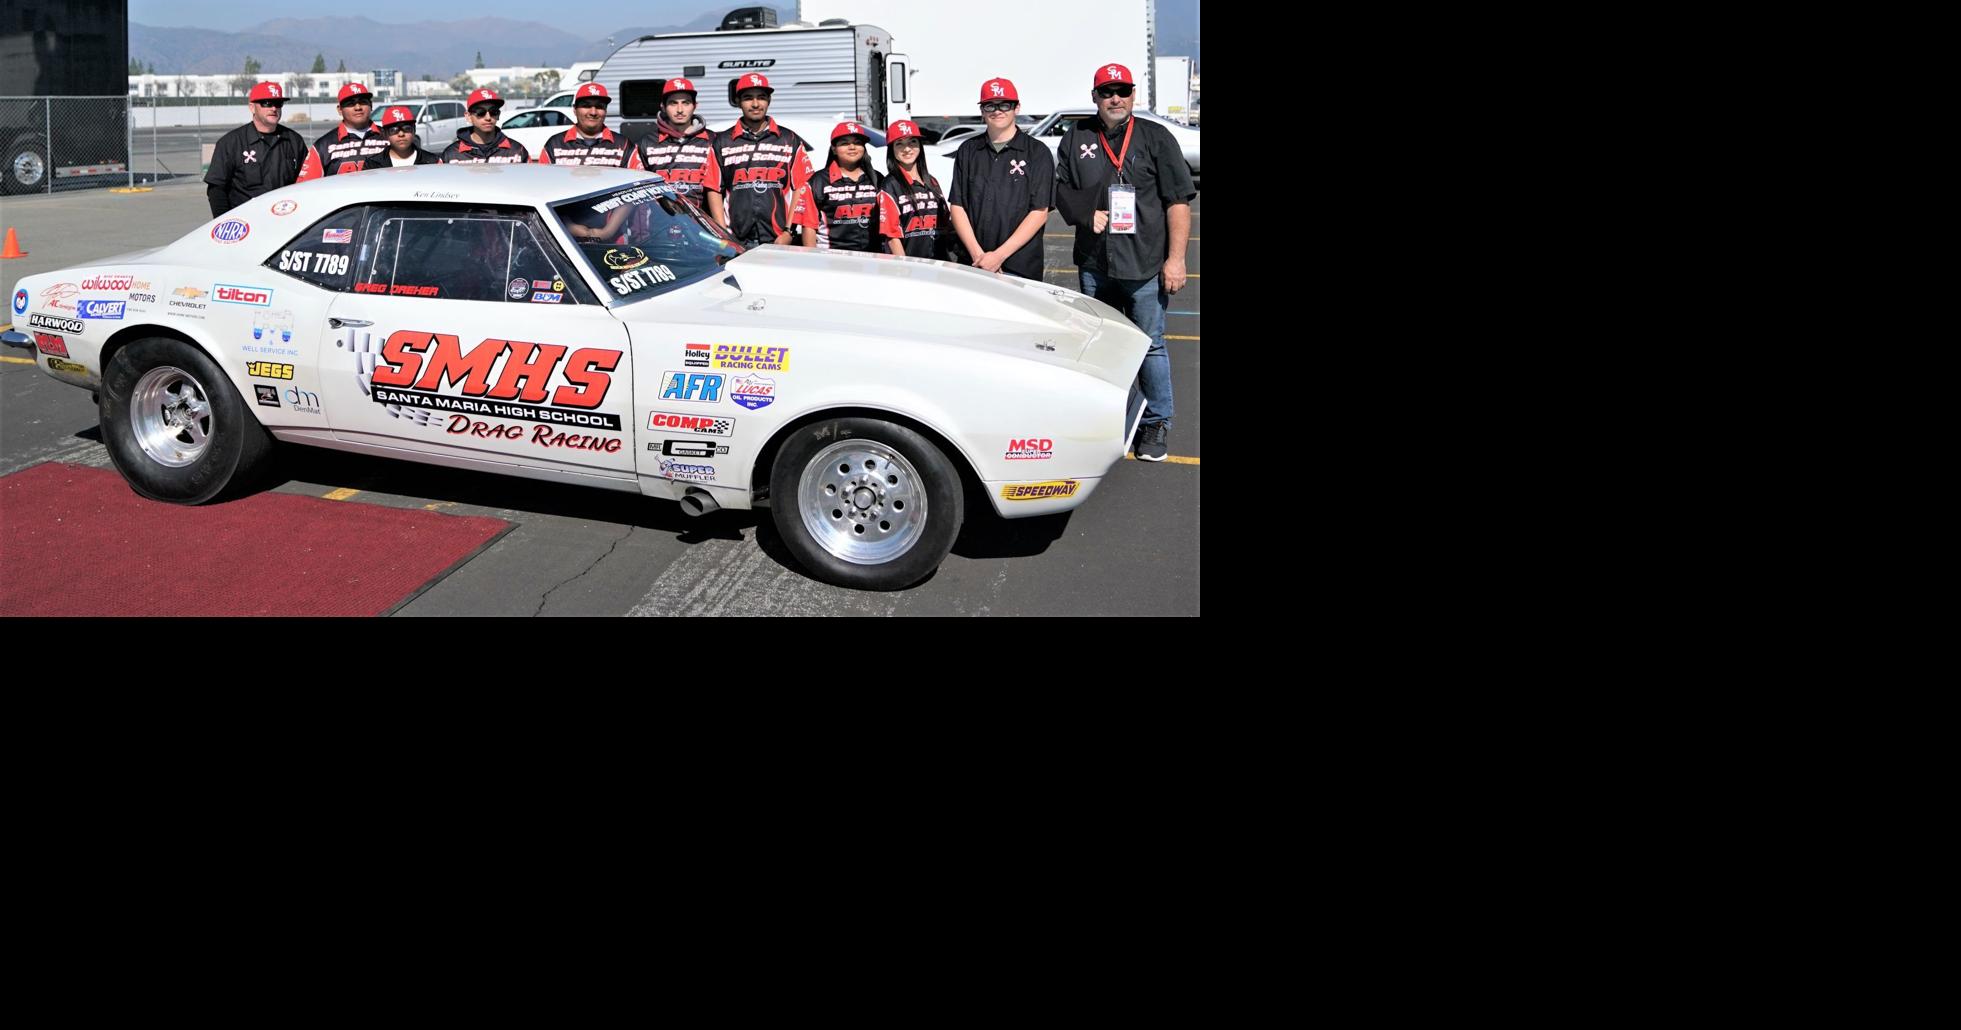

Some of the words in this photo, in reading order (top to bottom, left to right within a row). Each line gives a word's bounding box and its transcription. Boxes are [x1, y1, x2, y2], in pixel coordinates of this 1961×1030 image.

[721, 144, 756, 156] Santa
[724, 153, 750, 167] High
[752, 152, 792, 164] School
[732, 166, 786, 186] ARP
[823, 185, 857, 194] Santa
[214, 221, 246, 241] NHRA
[279, 250, 312, 273] S/ST
[313, 254, 349, 276] 7789
[610, 270, 648, 295] S/ST
[640, 264, 677, 284] 7789
[217, 287, 267, 304] tilton
[354, 282, 387, 293] GREG
[390, 284, 439, 296] DREHER
[129, 292, 156, 303] MOTORS
[86, 301, 124, 315] CALVERT
[169, 301, 207, 310] CHEVROLET
[31, 314, 84, 333] HARWOOD
[242, 345, 258, 353] WELL
[260, 347, 285, 355] SERVICE
[685, 349, 711, 361] Holley
[715, 345, 789, 363] BULLET
[249, 361, 293, 379] JEGS
[371, 330, 623, 410] SMHS
[720, 361, 753, 370] RACING
[756, 362, 782, 371] CAMS
[663, 373, 722, 401] AFR
[736, 384, 773, 395] LUCAS
[284, 385, 320, 408] dm
[743, 395, 774, 403] PRODUCTS
[376, 390, 433, 407] SANTA
[436, 398, 491, 413] MARIA
[494, 405, 536, 419] HIGH
[539, 410, 614, 427] SCHOOL
[653, 414, 714, 430] COMP
[447, 414, 523, 439] DRAG
[531, 423, 622, 453] RACING
[1008, 438, 1053, 452] MSD
[672, 463, 716, 475] SUPER
[674, 473, 717, 481] MUFFLER
[1015, 484, 1076, 497] SPEEDWAY
